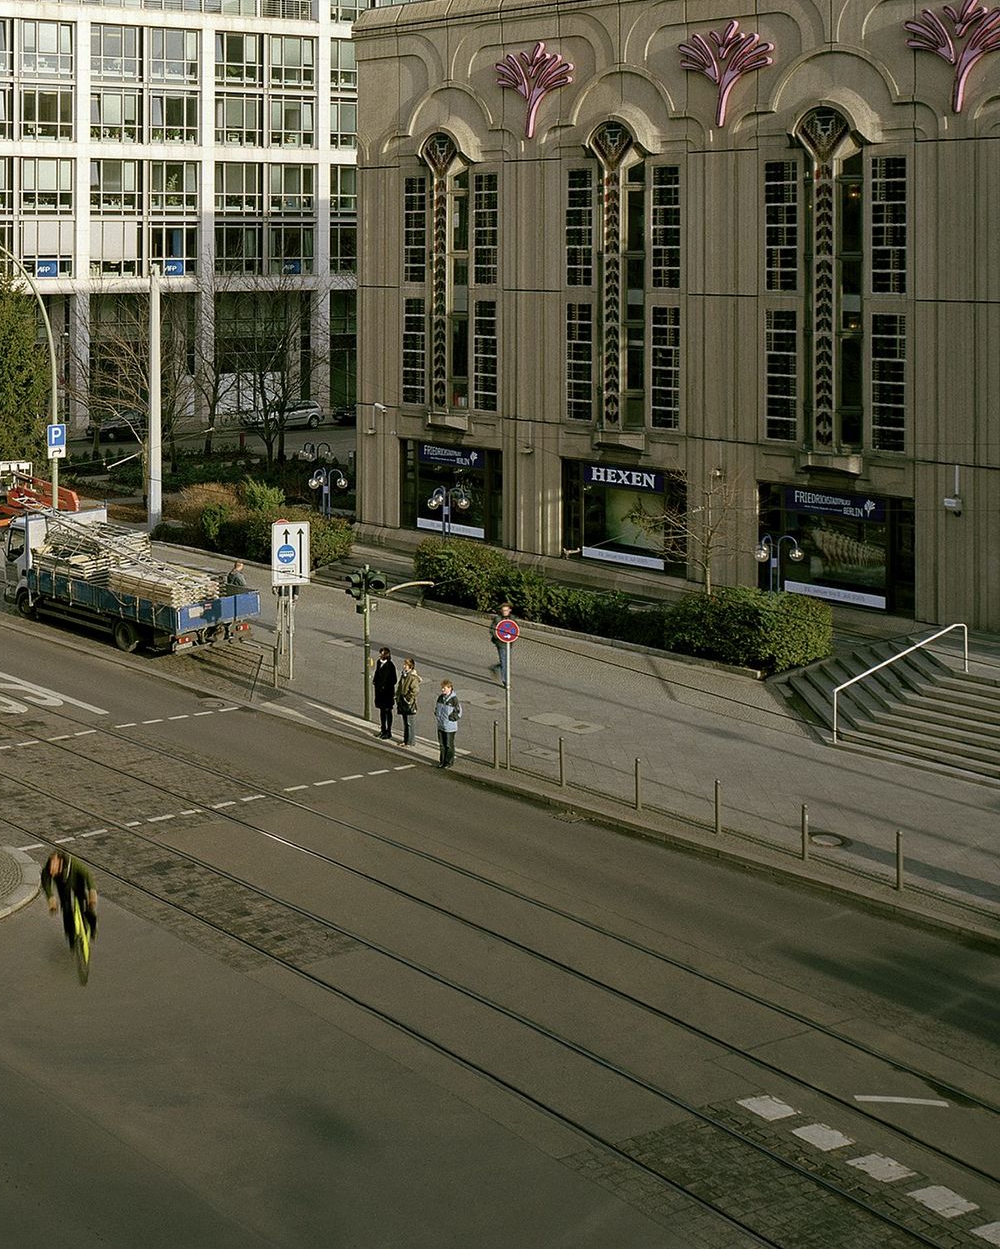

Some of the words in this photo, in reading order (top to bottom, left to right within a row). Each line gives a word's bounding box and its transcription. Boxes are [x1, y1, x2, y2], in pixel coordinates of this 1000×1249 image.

[165, 264, 178, 272] AFP
[52, 427, 62, 445] P
[591, 466, 656, 489] HEXEN
[843, 507, 864, 518] BERLIN
